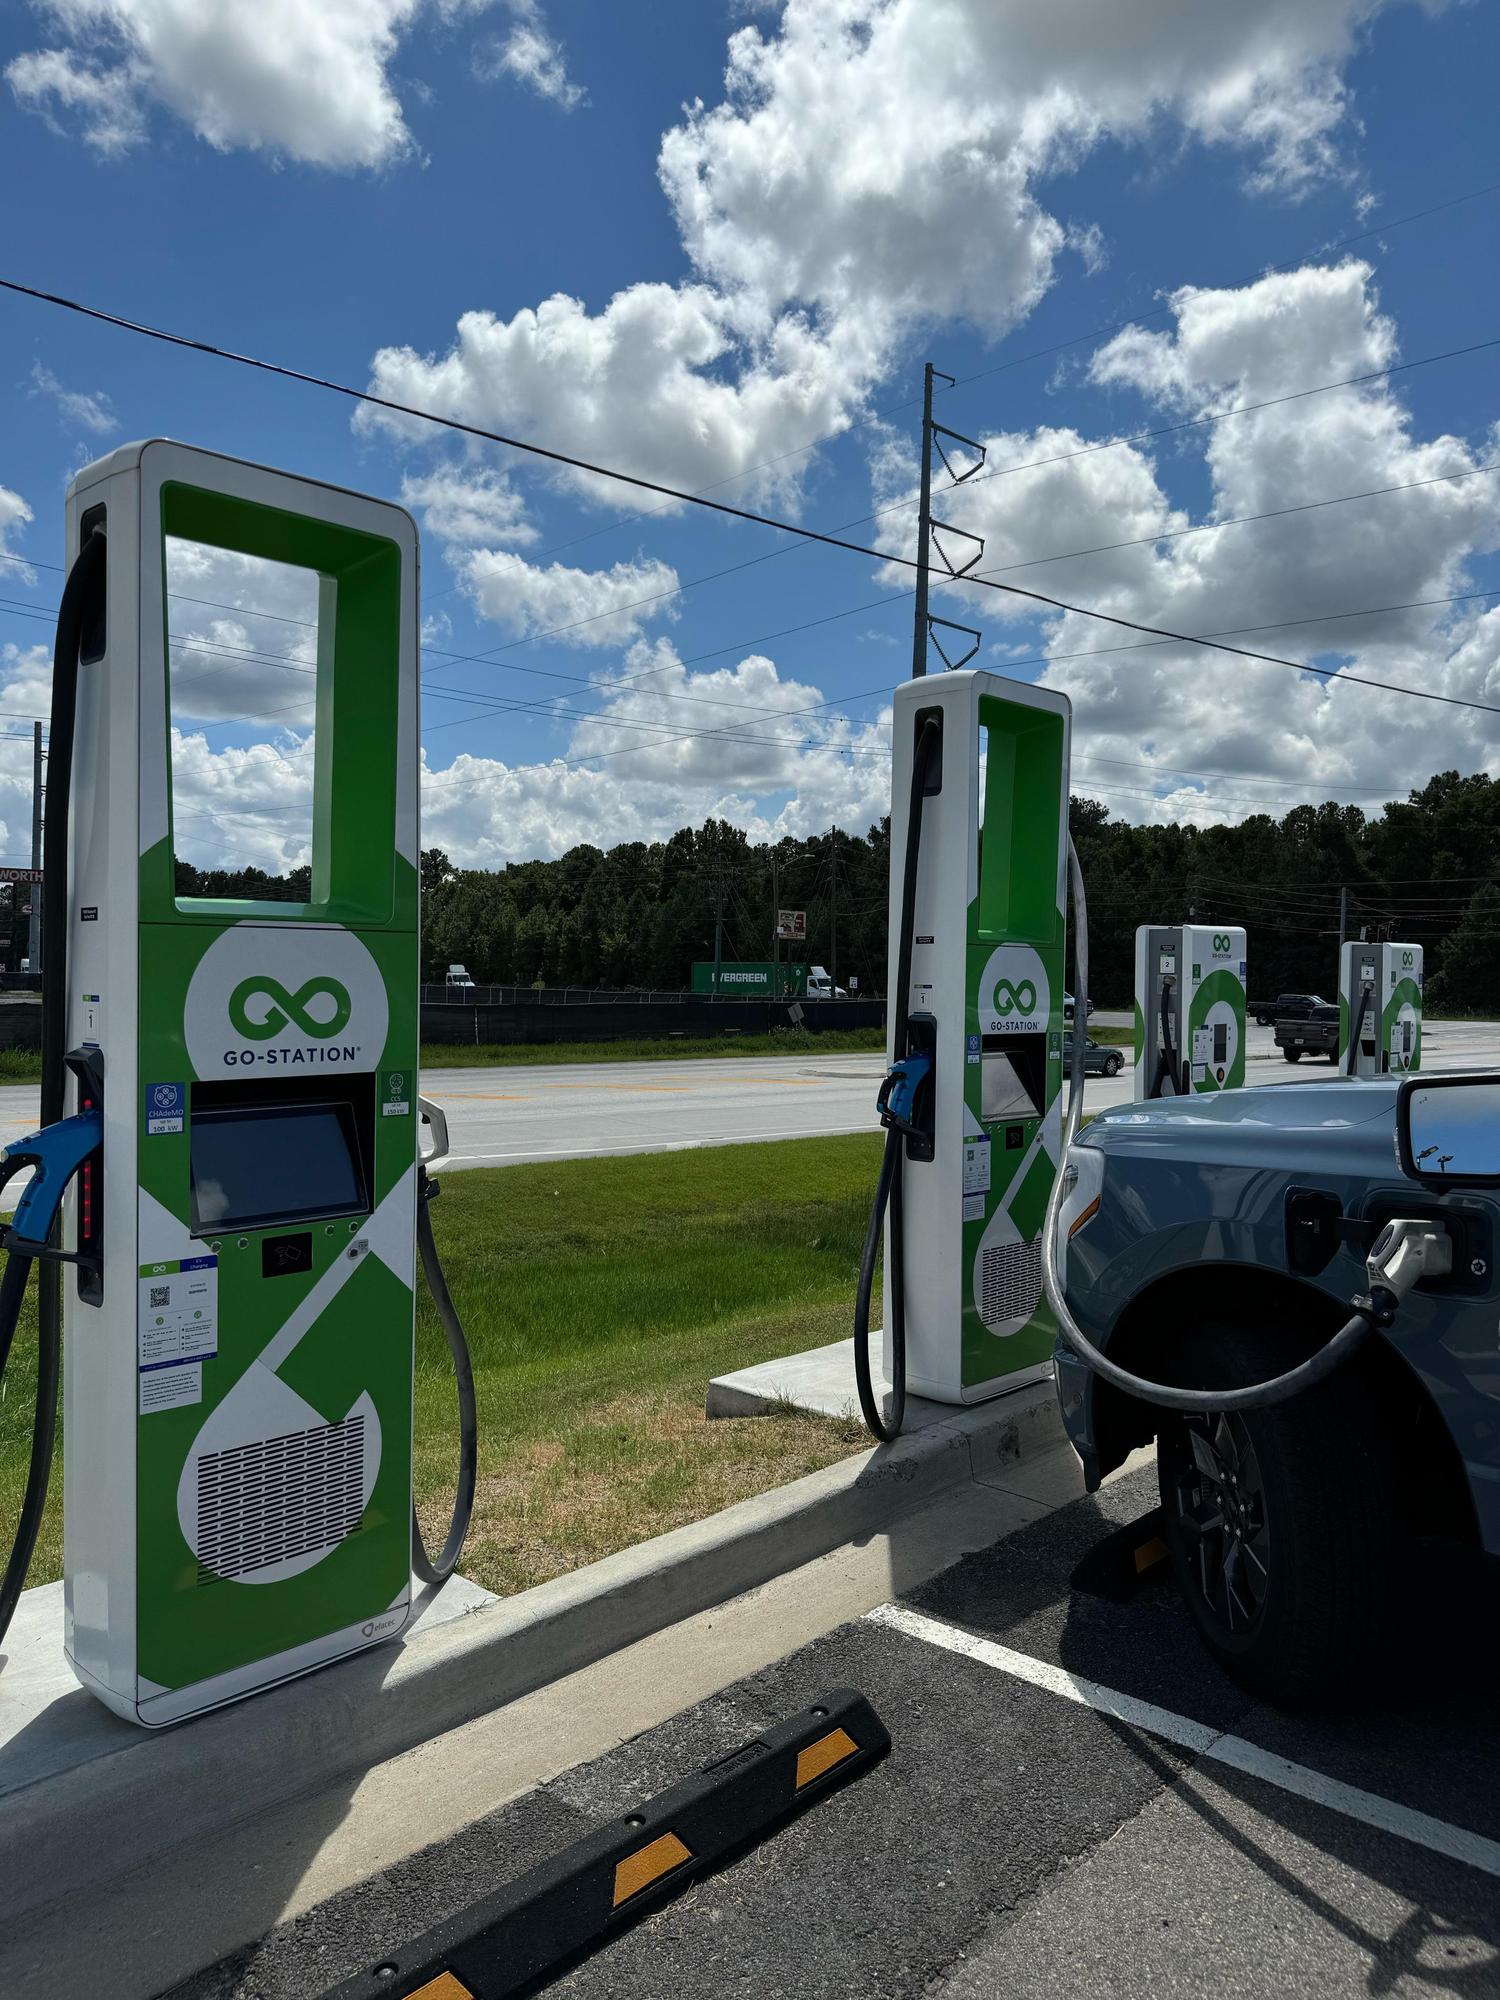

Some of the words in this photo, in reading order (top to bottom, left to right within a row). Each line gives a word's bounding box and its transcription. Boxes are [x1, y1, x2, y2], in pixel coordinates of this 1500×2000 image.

[712, 972, 767, 983] ERGREEN
[920, 995, 925, 1004] 1
[990, 1021, 1038, 1031] GO-STATION
[148, 1109, 184, 1118] CHAdeMO
